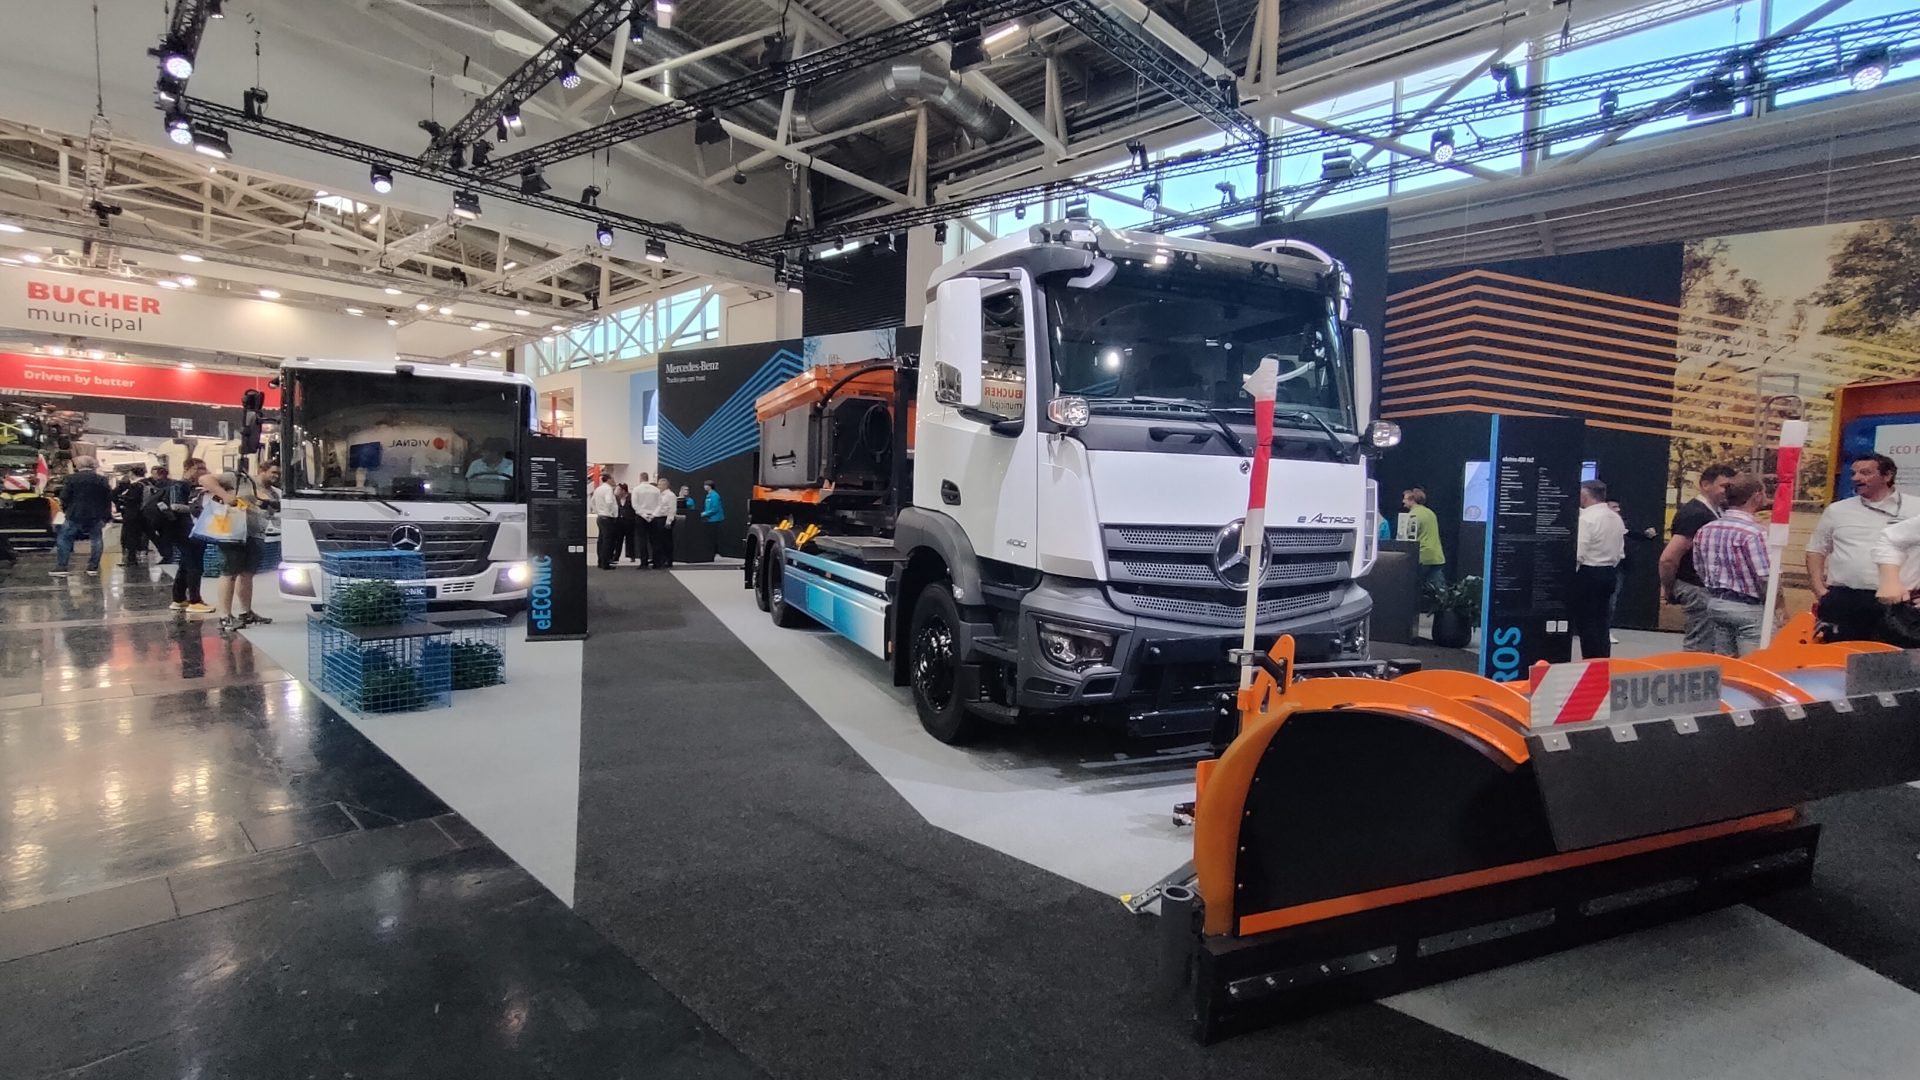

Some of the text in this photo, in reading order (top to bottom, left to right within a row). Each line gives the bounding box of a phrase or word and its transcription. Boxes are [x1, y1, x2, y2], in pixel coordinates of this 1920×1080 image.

[27, 281, 161, 315] BUCHER
[27, 307, 143, 332] municipal
[24, 369, 136, 388] Driven by better
[665, 361, 719, 373] Mercedes-Benz
[1889, 445, 1911, 455] ECO
[532, 555, 552, 630] eECONIC
[1610, 669, 1721, 713] BUCHER
